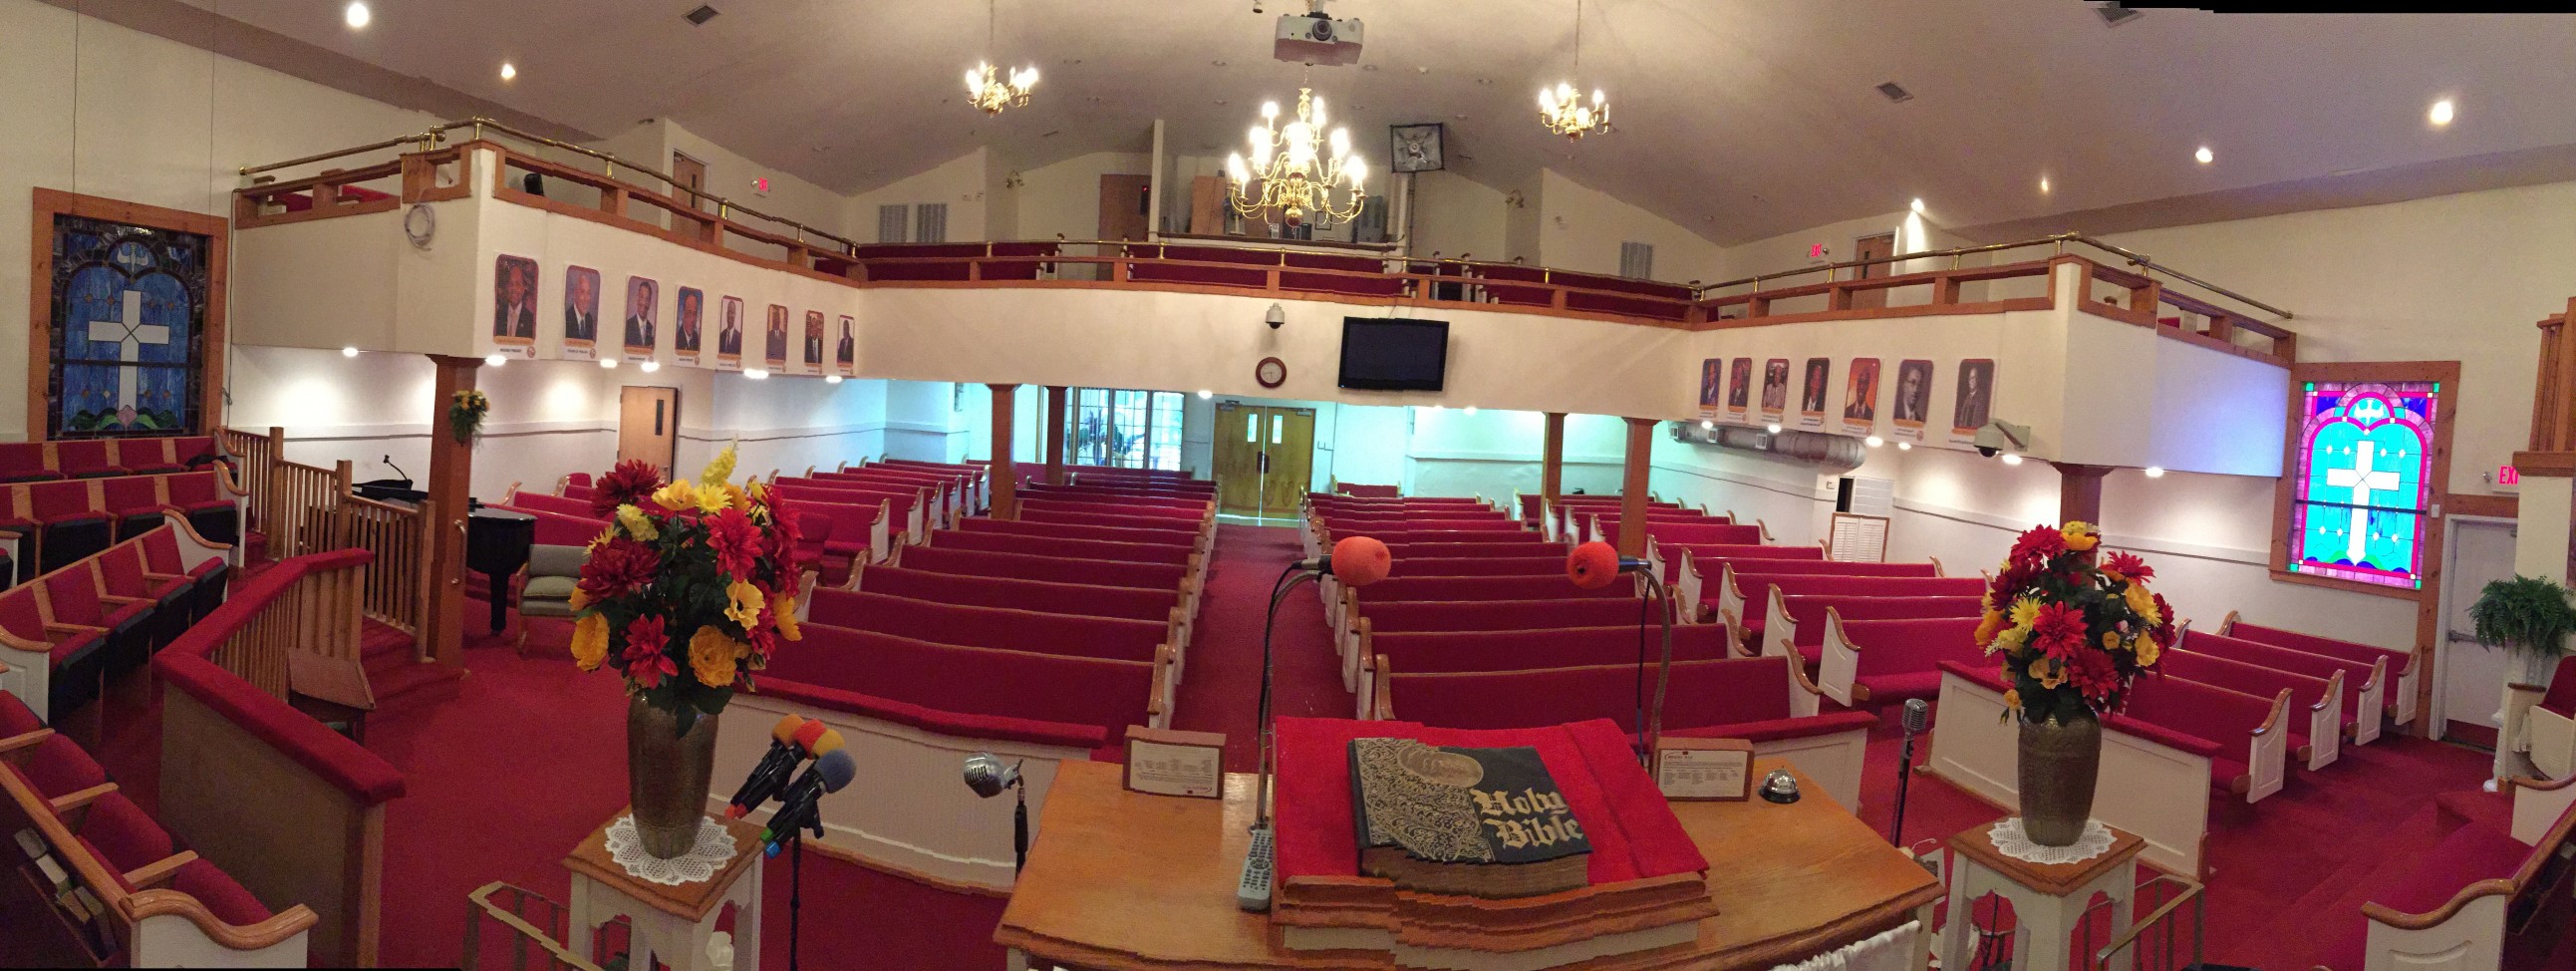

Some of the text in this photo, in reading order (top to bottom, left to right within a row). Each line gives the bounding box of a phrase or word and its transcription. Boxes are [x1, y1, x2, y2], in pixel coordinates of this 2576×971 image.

[2498, 466, 2518, 485] EXI
[1469, 787, 1570, 815] Holy
[1483, 814, 1584, 848] Bible
